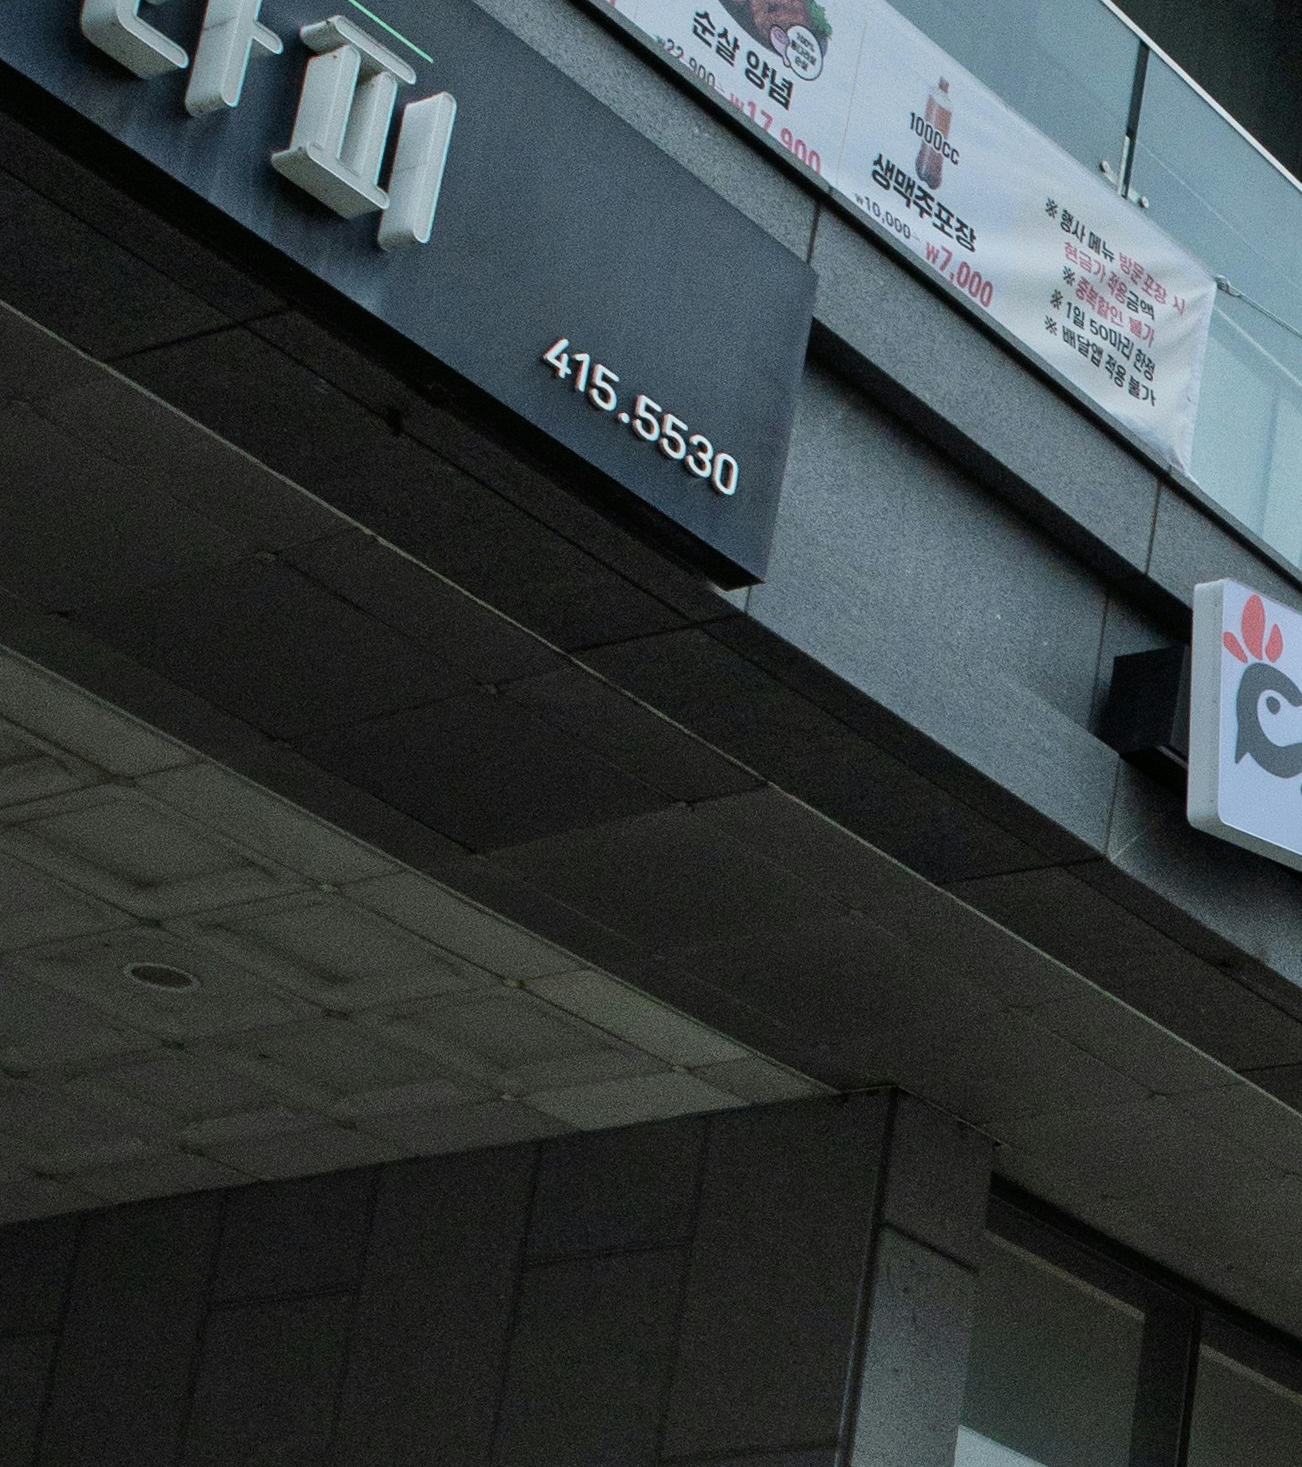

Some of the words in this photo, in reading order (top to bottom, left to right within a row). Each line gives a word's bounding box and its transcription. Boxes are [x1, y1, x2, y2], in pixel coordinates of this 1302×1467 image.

[692, 10, 740, 68] 순살
[744, 50, 795, 111] 양념
[910, 112, 960, 166] 1000cc
[871, 152, 977, 254] 생맥주포장
[1061, 209, 1087, 244] 행사
[1088, 230, 1116, 263] 메뉴
[1062, 325, 1104, 368] 배달앱
[1128, 376, 1157, 407] 불가
[1066, 302, 1086, 330] 1일
[1089, 320, 1135, 361] 50마리
[1135, 348, 1156, 382] 한정
[541, 337, 741, 499] 415.5530
